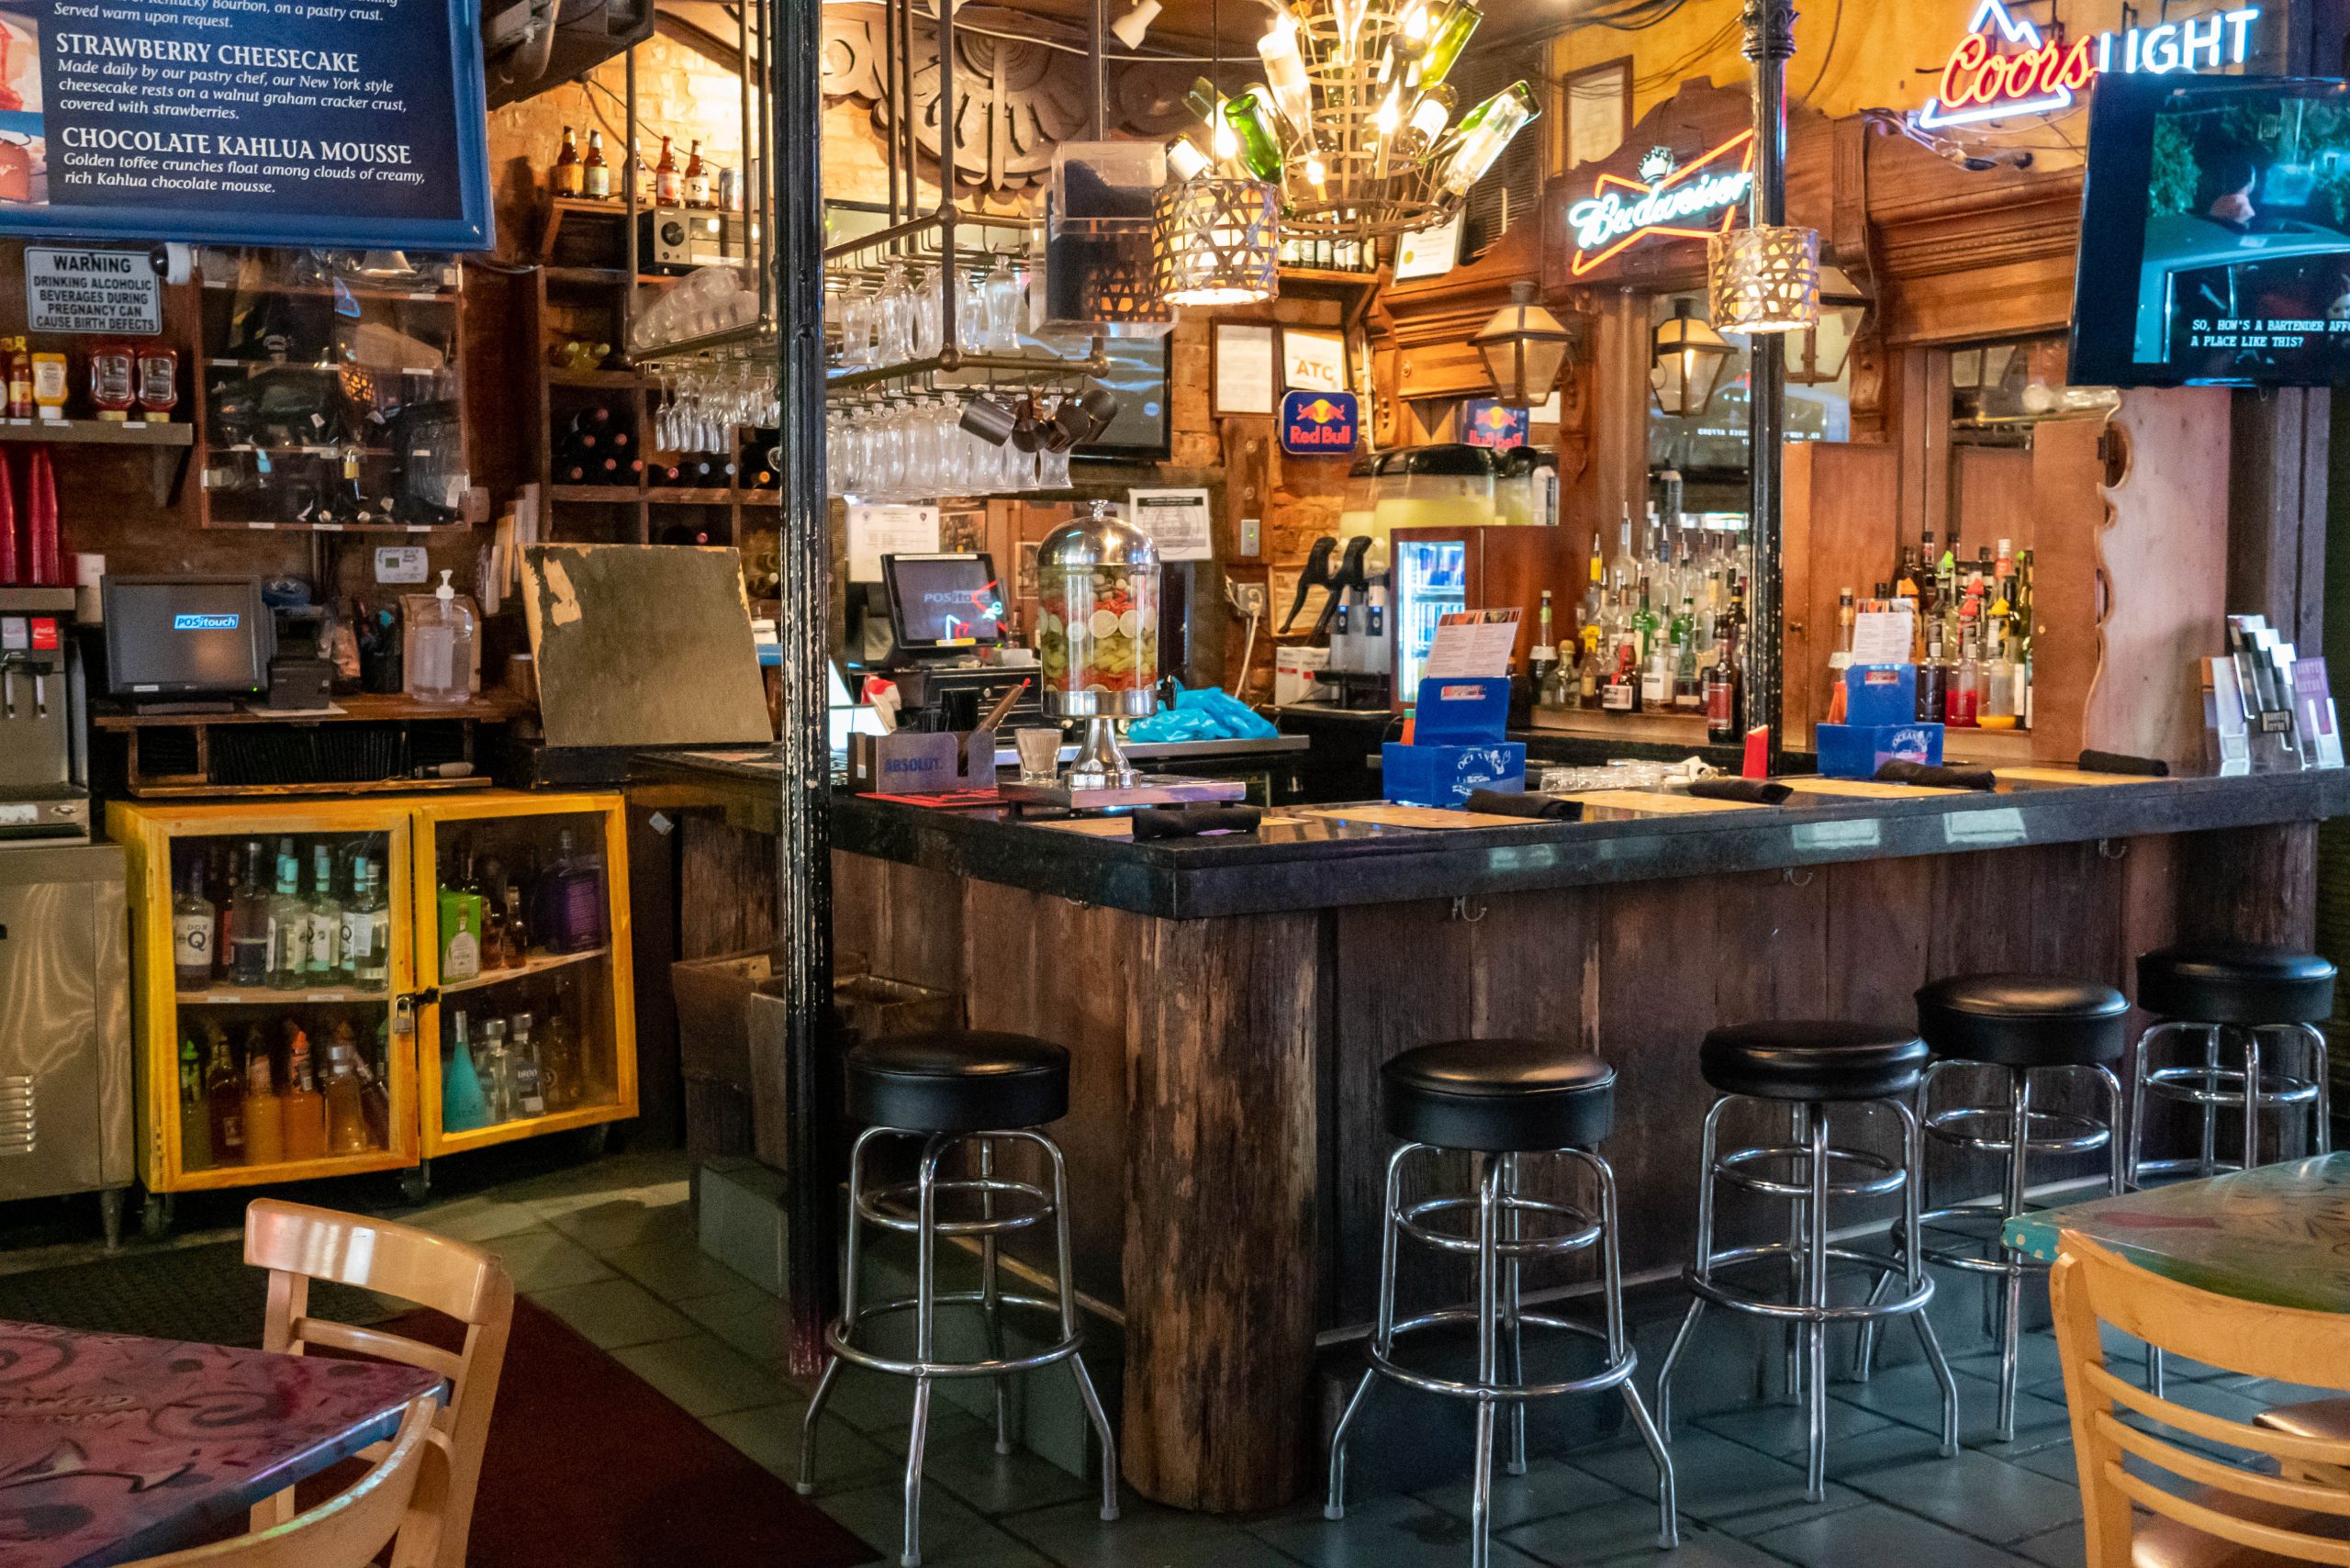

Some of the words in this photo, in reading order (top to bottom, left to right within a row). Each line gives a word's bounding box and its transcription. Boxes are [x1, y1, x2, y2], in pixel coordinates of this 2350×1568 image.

[54, 2, 98, 17] Served
[102, 8, 140, 20] warm
[145, 12, 178, 26] upon
[183, 15, 233, 29] request.
[212, 0, 270, 14] Bourbon,
[275, 4, 290, 13] on
[295, 6, 303, 15] a
[307, 6, 346, 21] pastry
[350, 8, 384, 20] crust.
[56, 33, 210, 62] STRAWBERRY
[218, 45, 359, 73] CHEESECAKE
[58, 59, 98, 73] Made
[103, 62, 137, 79] daily
[141, 65, 158, 81] by
[162, 69, 185, 79] our
[189, 70, 232, 84] pastry
[236, 72, 268, 86] chef,
[273, 76, 295, 86] our
[299, 75, 329, 88] New
[332, 77, 361, 91] York
[364, 80, 394, 95] style
[1939, 32, 2099, 108] Coors
[59, 78, 138, 95] cheesecake
[141, 84, 173, 96] rests
[177, 87, 195, 97] on
[199, 89, 208, 99] a
[213, 89, 259, 103] walnut
[263, 92, 317, 106] graham
[321, 96, 368, 109] cracker
[371, 99, 407, 113] crust,
[60, 99, 114, 112] covered
[118, 101, 148, 114] with
[152, 104, 240, 119] strawberries.
[62, 127, 211, 154] CHOCOLATE
[218, 136, 315, 160] KAHLUA
[320, 141, 412, 164] MOUSSE
[63, 152, 115, 167] Golden
[119, 156, 158, 170] toffee
[162, 159, 223, 173] crunches
[228, 161, 258, 174] float
[263, 166, 309, 180] among
[314, 166, 355, 179] clouds
[359, 168, 375, 180] of
[375, 170, 425, 185] creamy,
[65, 172, 92, 185] rich
[96, 173, 147, 186] Kahlua
[151, 175, 218, 191] chocolate
[221, 182, 275, 193] mousse.
[1568, 172, 1753, 249] Budweiser
[53, 255, 131, 274] WARNING
[34, 276, 87, 288] DRINKING
[92, 278, 152, 291] ALCOHOLIC
[39, 290, 104, 303] BEVERAGES
[107, 293, 148, 305] DURING
[48, 304, 116, 316] PREGNANCY
[119, 306, 142, 317] CAN
[36, 316, 72, 328] CAUSE
[74, 317, 106, 329] BIRTH
[109, 319, 154, 330] DEFECTS
[2192, 319, 2210, 332] SO,
[2217, 319, 2250, 330] HOW'S
[2255, 320, 2263, 330] A
[2266, 320, 2324, 331] BARTENDER
[2328, 320, 2350, 331] AFF
[2190, 336, 2199, 346] A
[2203, 336, 2237, 347] PLACE
[2241, 336, 2267, 347] LIKE
[2272, 336, 2305, 347] THIS?
[1296, 360, 1334, 381] ATC
[1290, 425, 1320, 444] Red
[1322, 425, 1351, 444] Bull
[175, 616, 237, 628] POSitouch
[187, 930, 207, 952] Q
